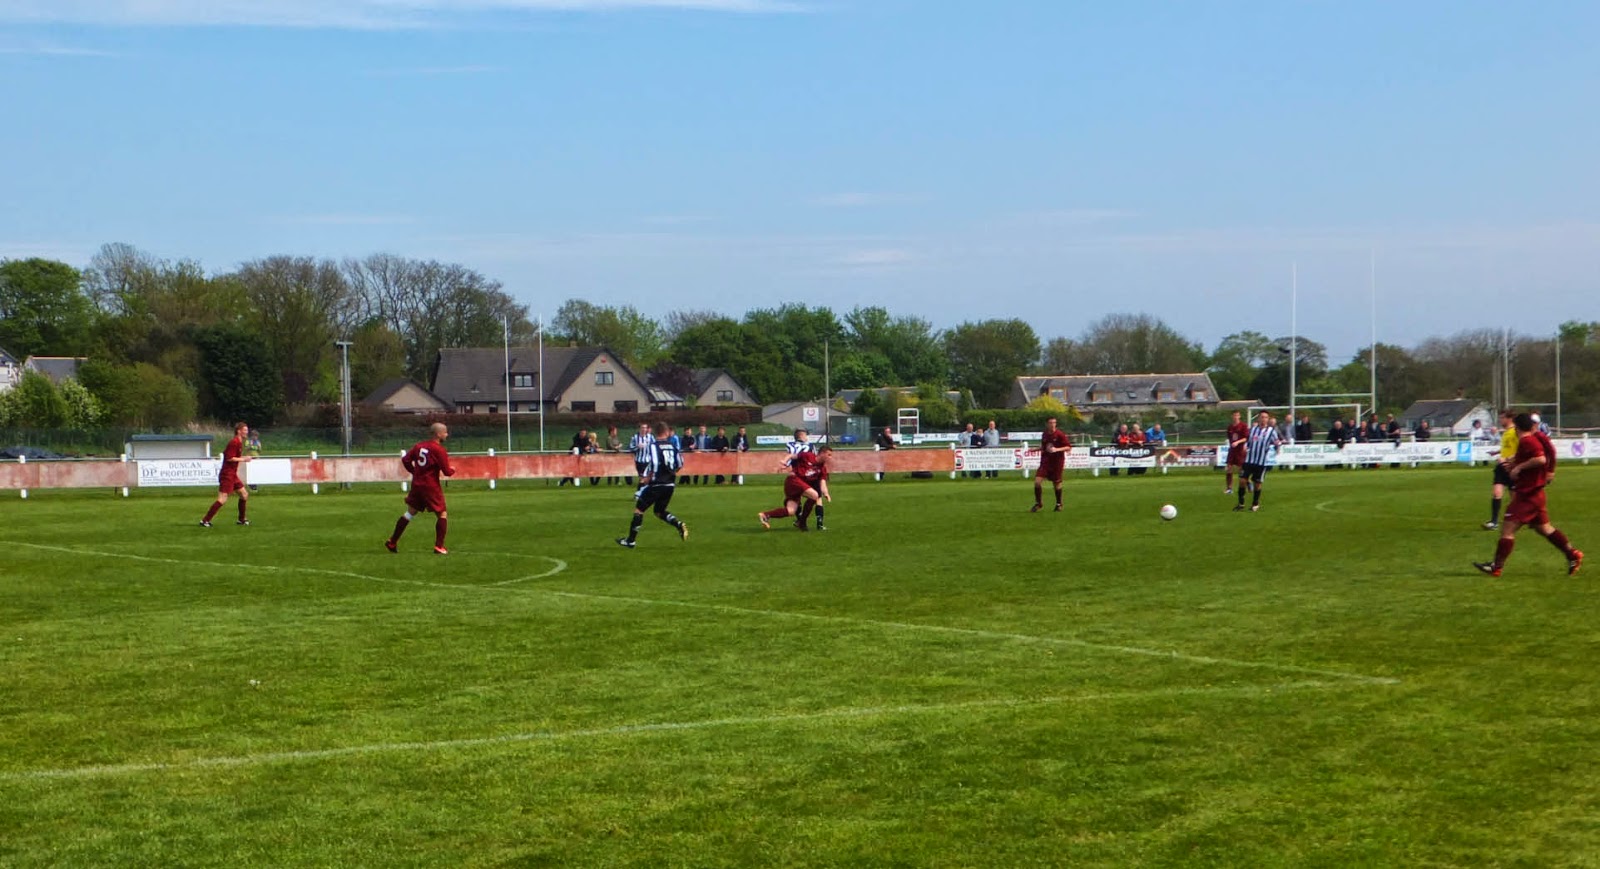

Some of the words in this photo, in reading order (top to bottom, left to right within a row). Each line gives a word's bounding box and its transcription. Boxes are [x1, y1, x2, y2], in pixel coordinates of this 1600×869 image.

[1095, 447, 1150, 456] chocolate
[417, 447, 429, 467] 5
[142, 468, 157, 477] DP
[160, 469, 211, 477] PROPERTIES
